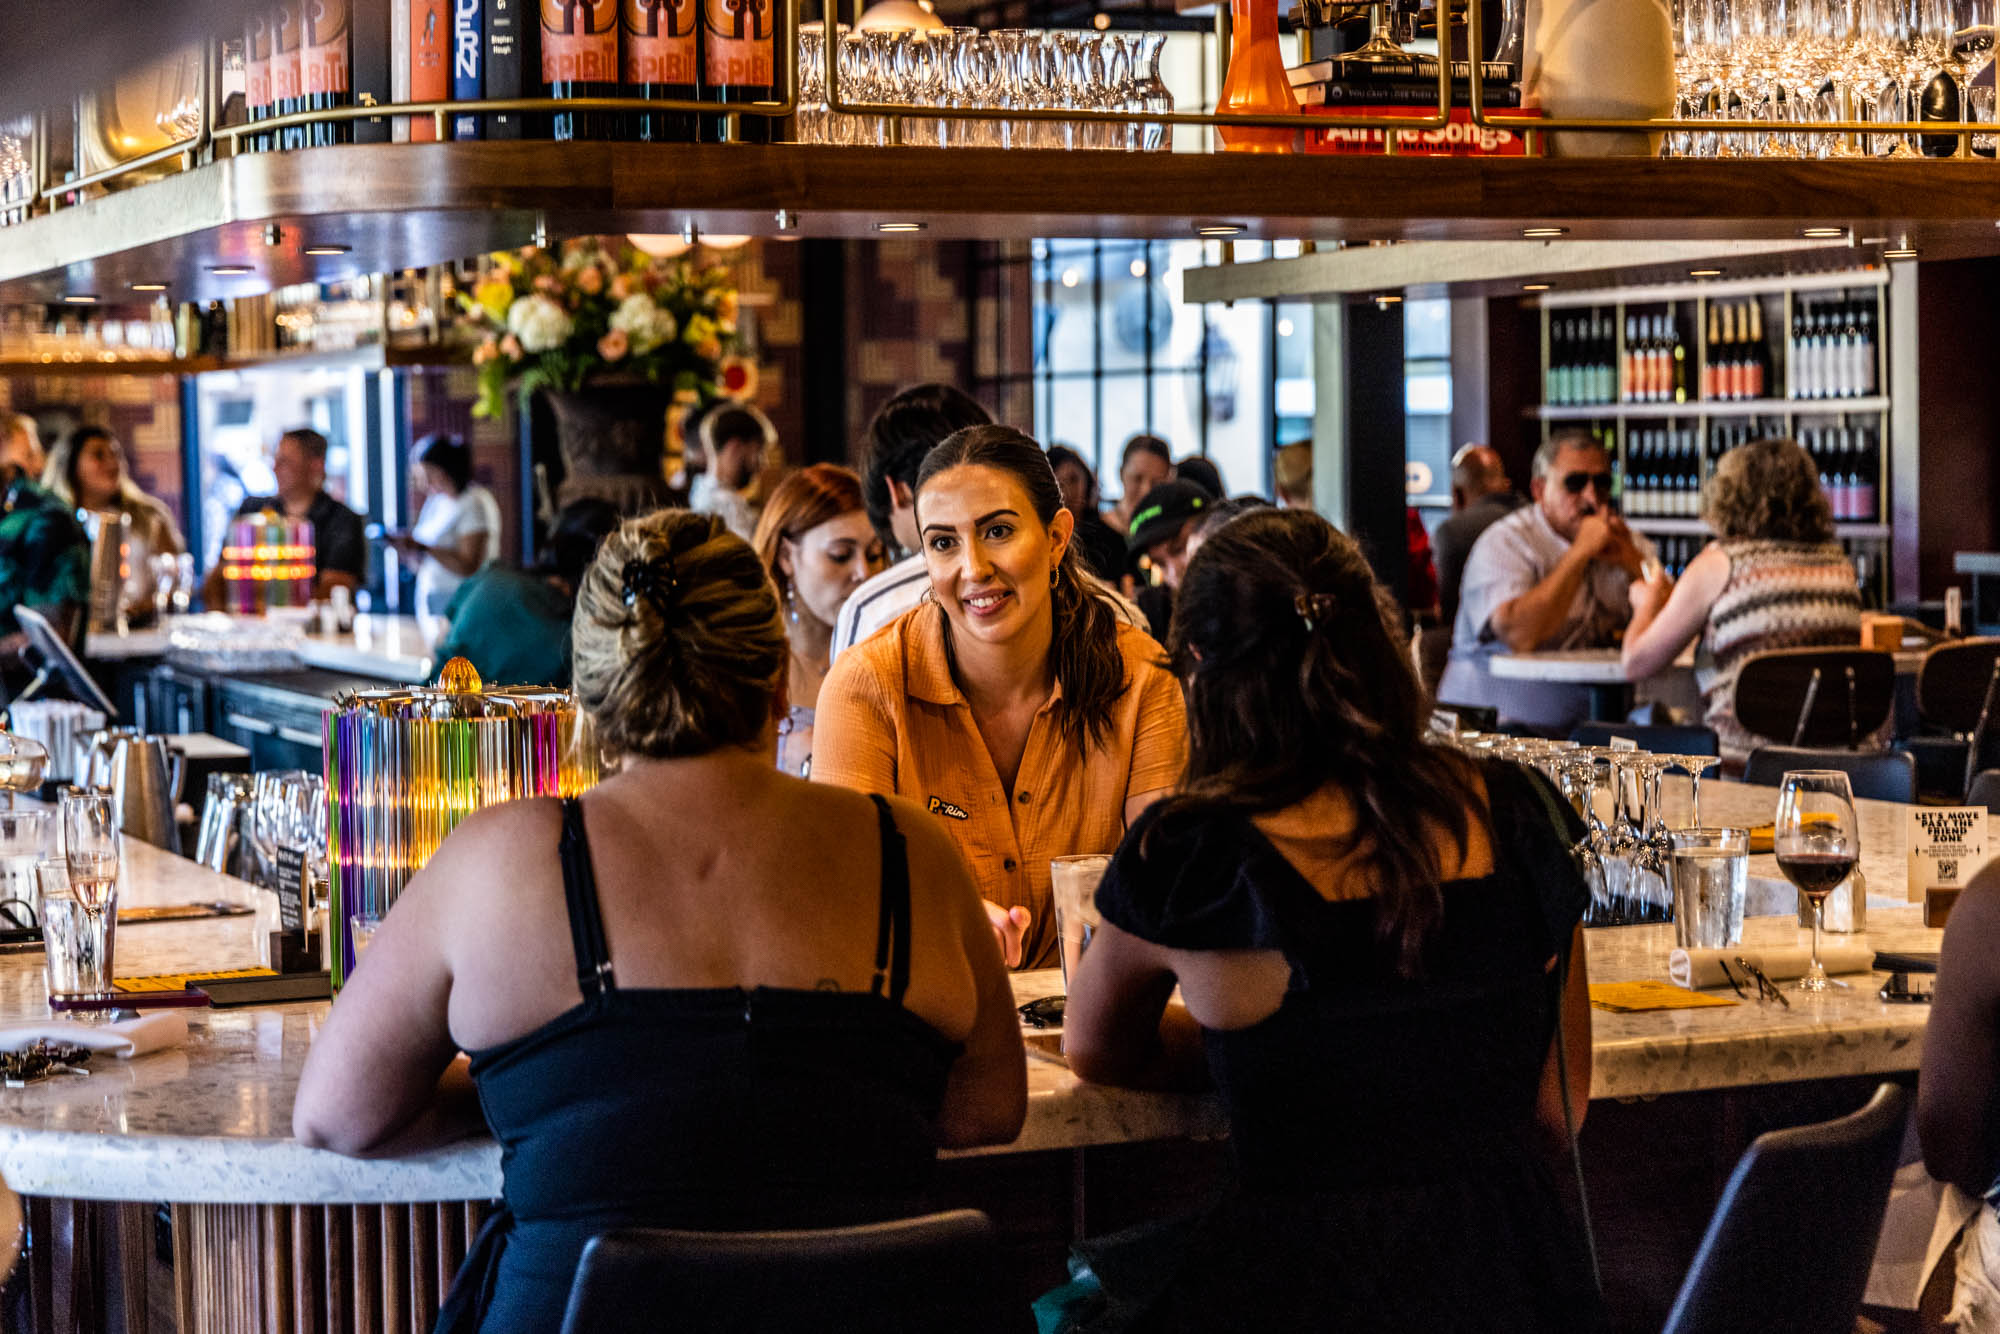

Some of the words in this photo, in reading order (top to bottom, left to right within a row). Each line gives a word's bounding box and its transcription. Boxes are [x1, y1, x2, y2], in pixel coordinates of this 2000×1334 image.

[1423, 122, 1512, 151] Songs
[1915, 812, 1943, 820] LET'S
[1948, 811, 1979, 819] MOVE
[1922, 819, 1948, 827] PAST
[1954, 819, 1973, 827] THE
[1928, 827, 1967, 835] FRIEND
